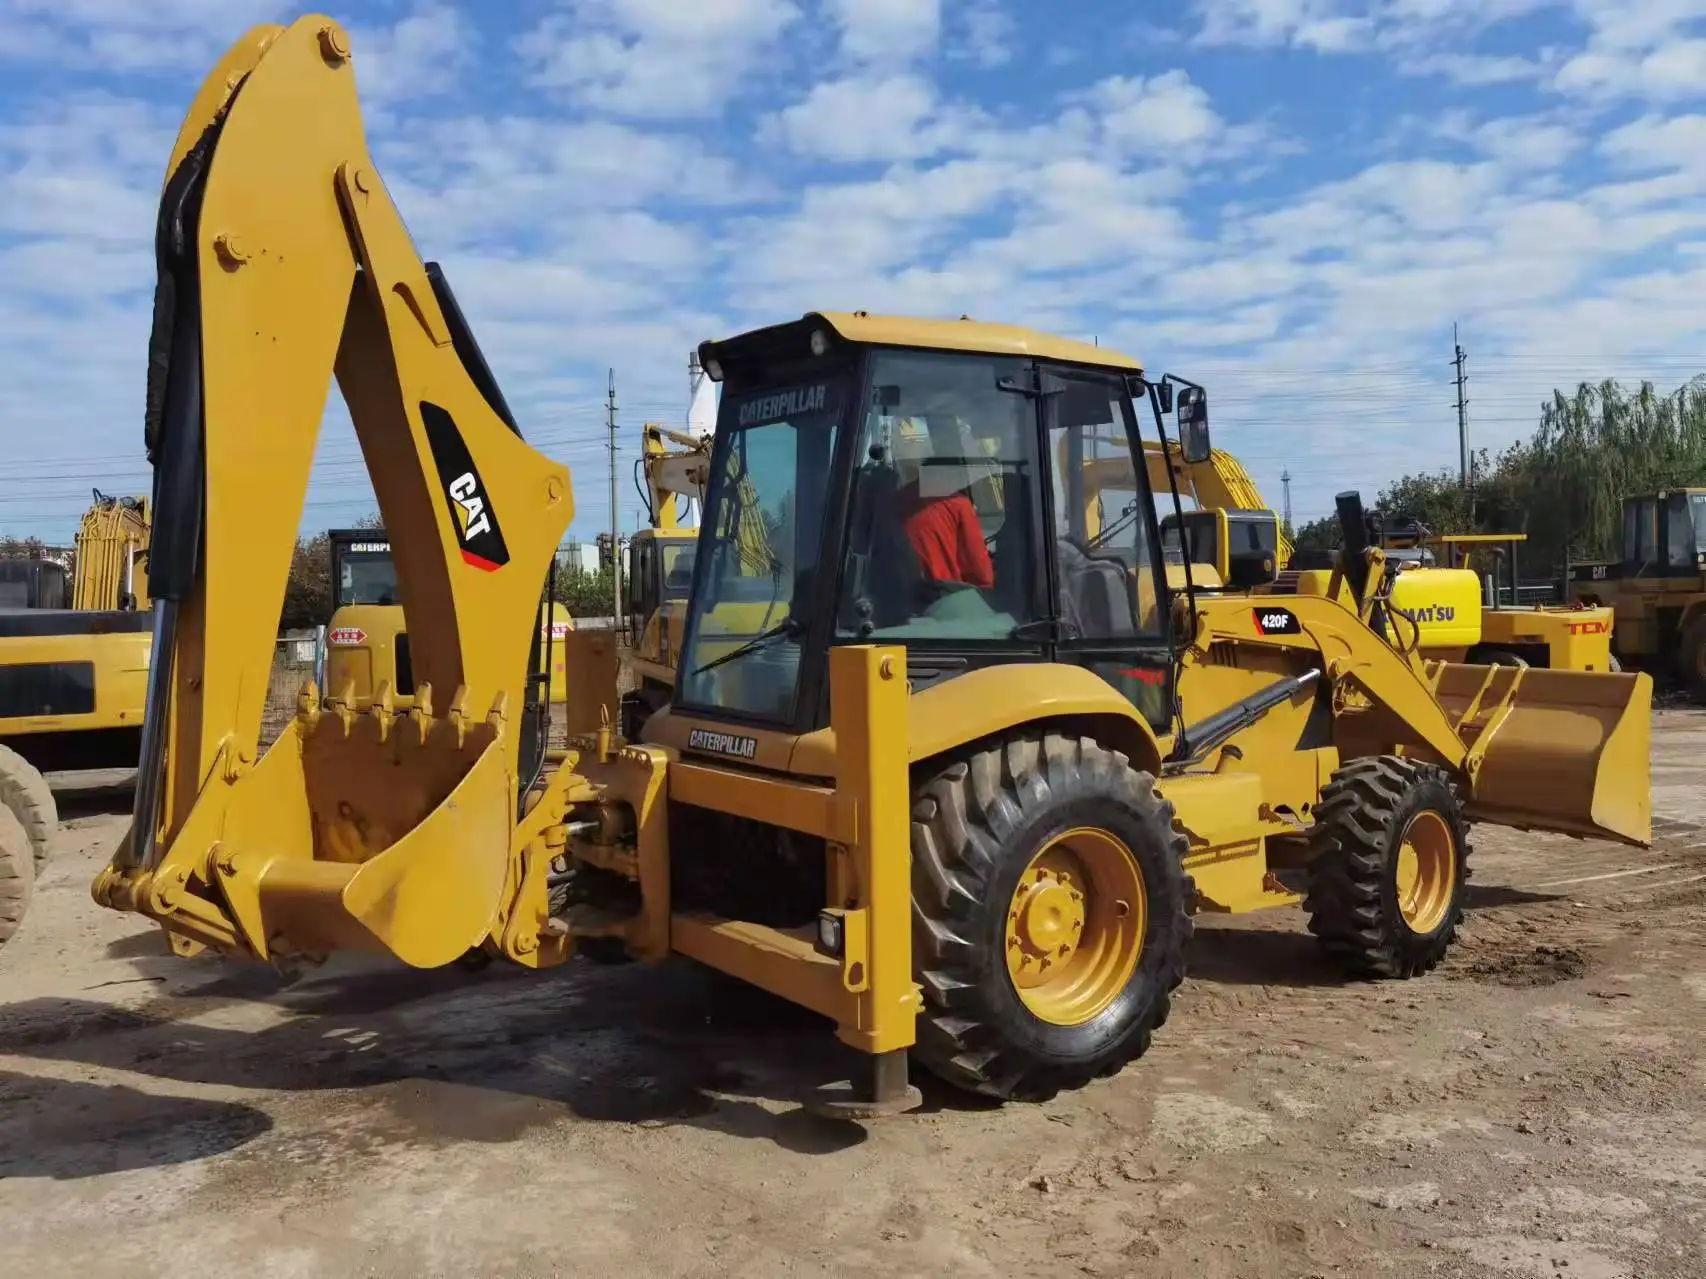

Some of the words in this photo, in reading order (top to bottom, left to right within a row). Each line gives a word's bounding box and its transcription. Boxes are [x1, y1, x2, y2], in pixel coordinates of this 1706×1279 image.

[738, 384, 826, 424] CATERPILLAR
[450, 472, 491, 541] CAT
[351, 542, 391, 552] CATERPI
[1592, 566, 1607, 580] CAT
[1261, 614, 1288, 628] 420F
[1384, 603, 1455, 622] MATSU
[689, 730, 756, 758] CATERPILLAR
